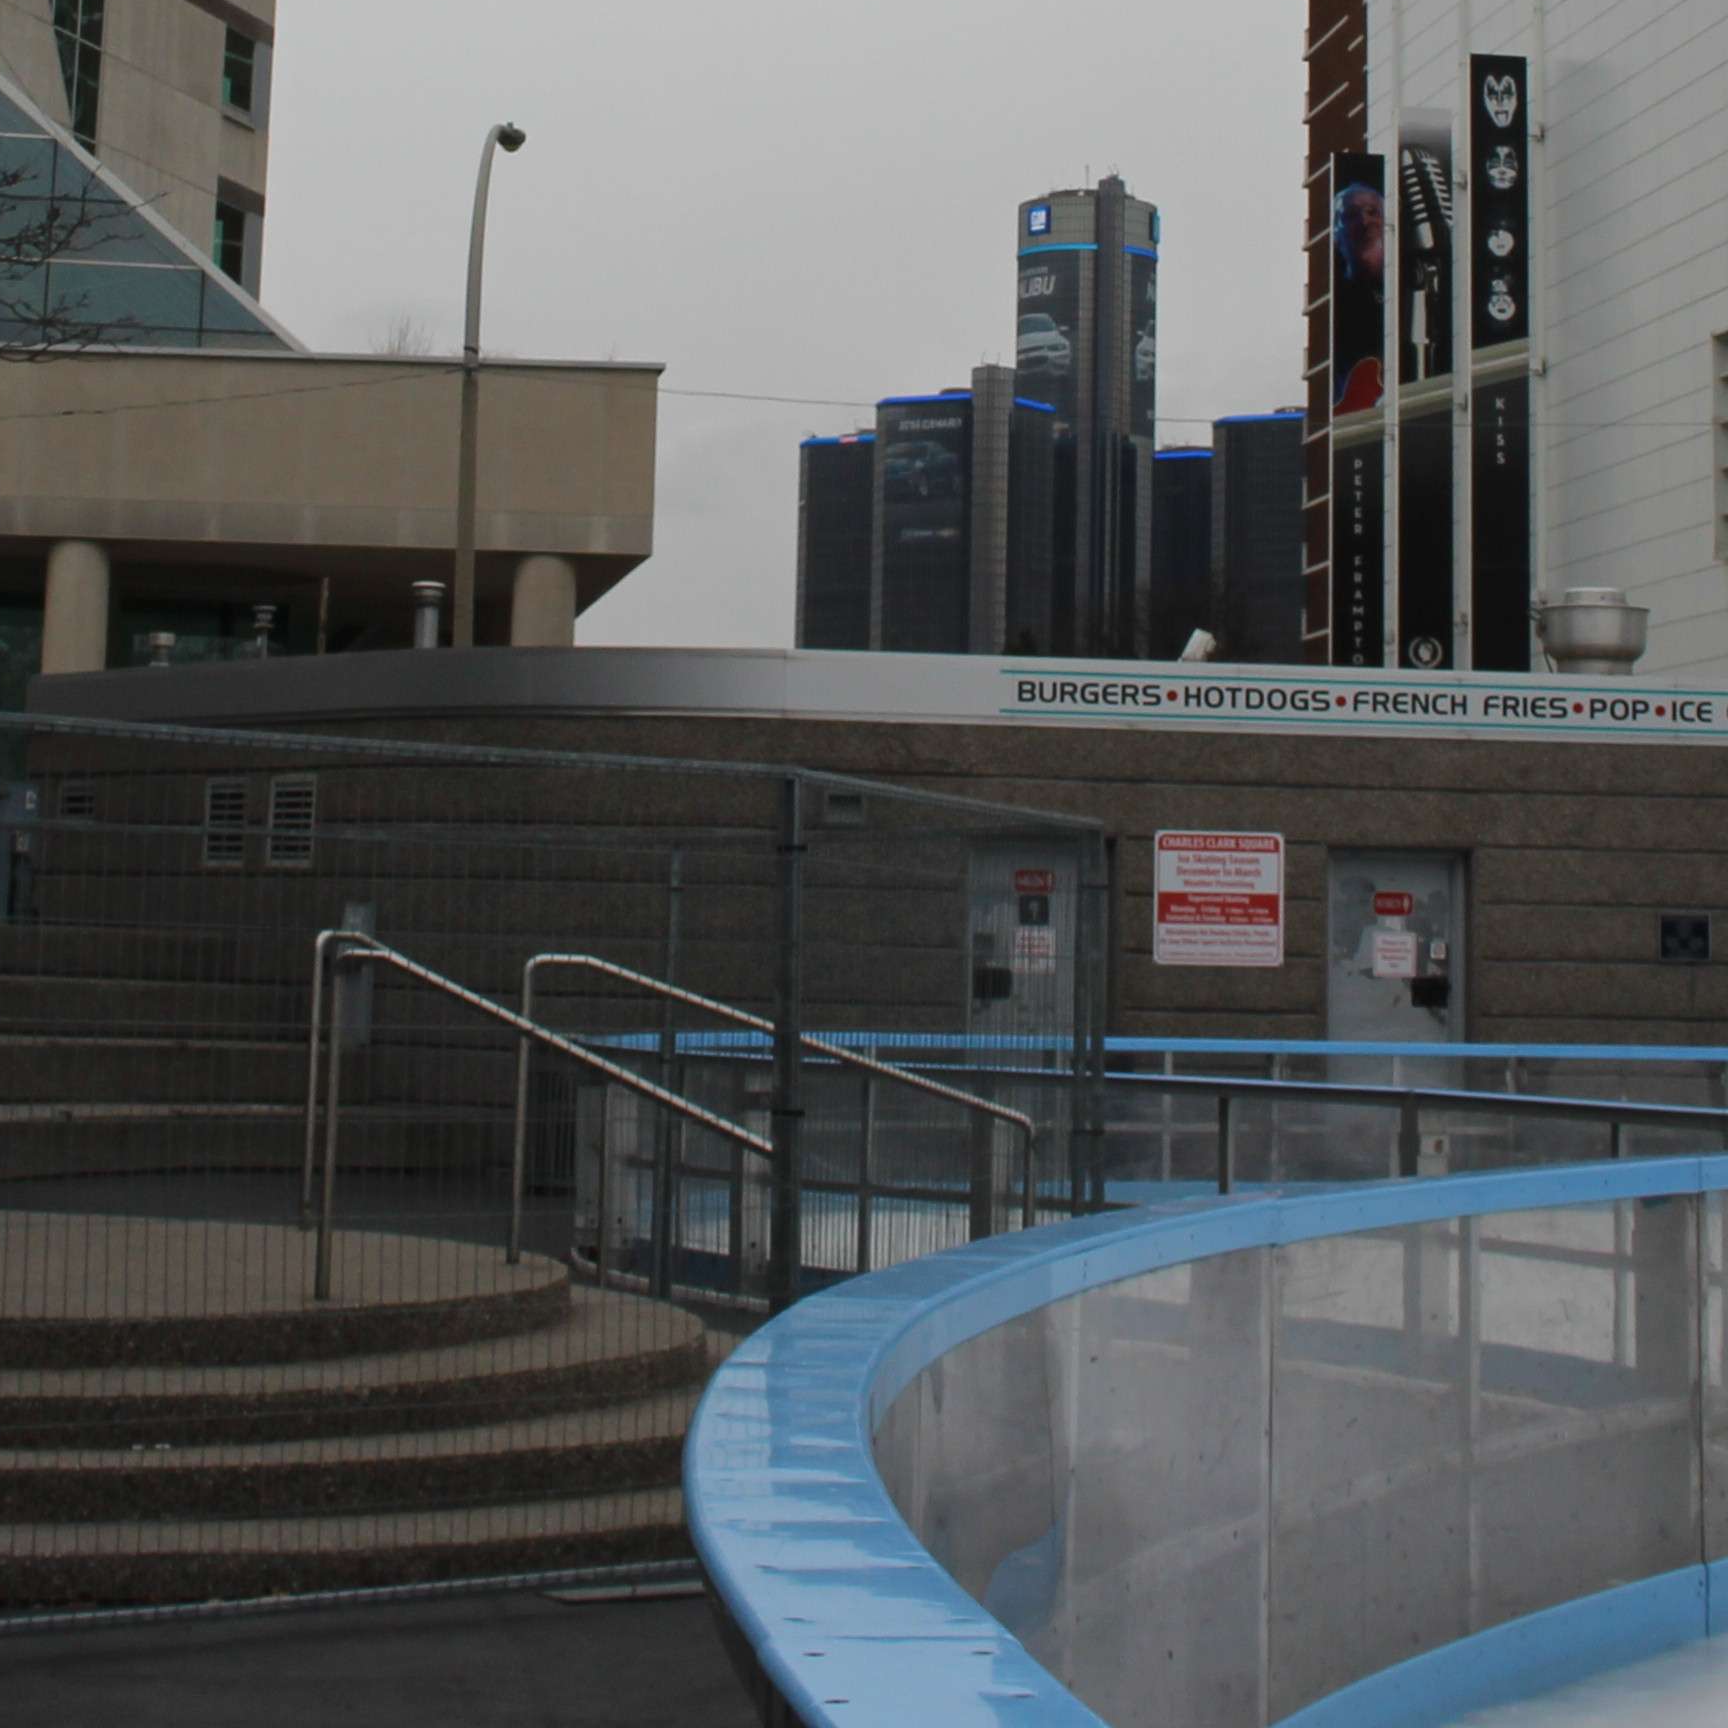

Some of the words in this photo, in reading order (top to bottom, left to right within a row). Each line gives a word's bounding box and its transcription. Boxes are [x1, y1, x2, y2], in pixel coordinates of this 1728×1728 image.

[1495, 397, 1505, 465] KISS
[1353, 458, 1363, 535] PETER
[1352, 555, 1364, 666] FRAMPTO
[1017, 681, 1162, 706] BURGERS
[1184, 685, 1331, 712] HOTDOGS
[1352, 691, 1467, 716] FRENCH
[1482, 695, 1568, 719] FRIES
[1588, 698, 1649, 722] POP
[1671, 701, 1713, 723] ICE
[1162, 836, 1204, 848] CHARLES
[1206, 837, 1236, 849] CLARK
[1238, 838, 1275, 850] SQUARE
[1176, 866, 1221, 876] December
[1234, 867, 1262, 877] March
